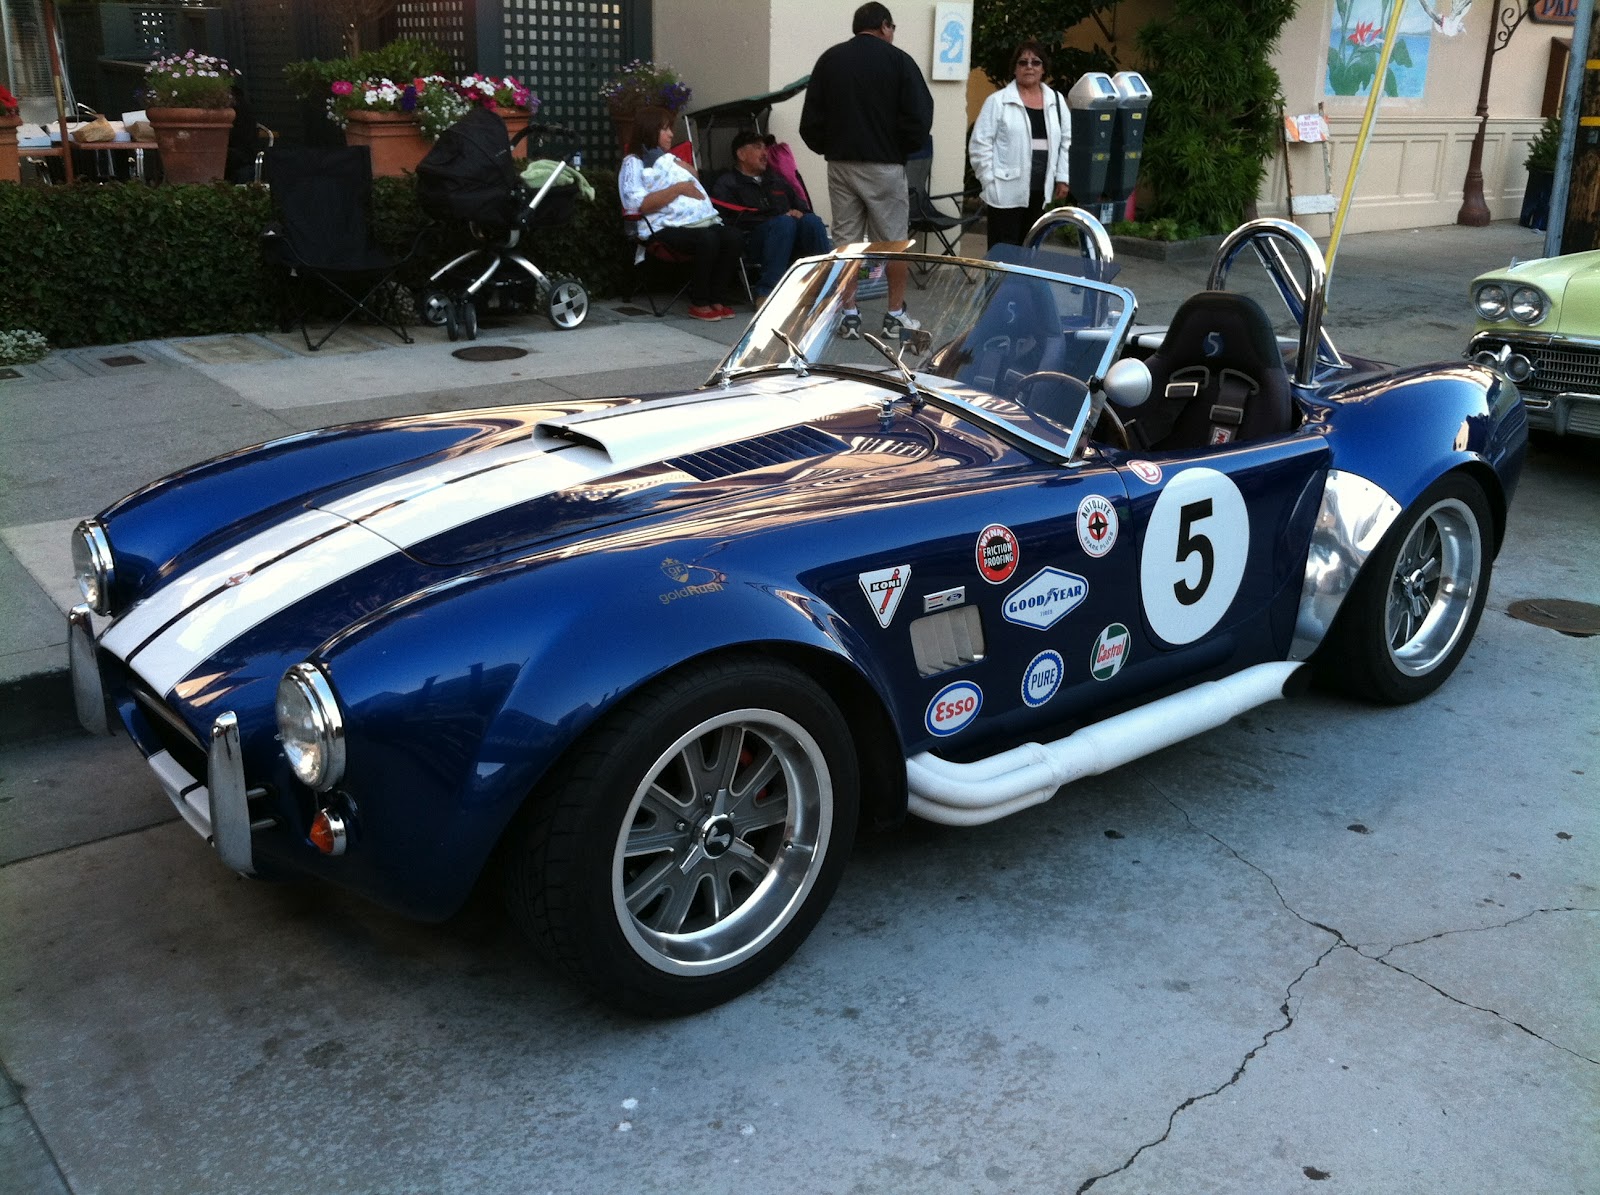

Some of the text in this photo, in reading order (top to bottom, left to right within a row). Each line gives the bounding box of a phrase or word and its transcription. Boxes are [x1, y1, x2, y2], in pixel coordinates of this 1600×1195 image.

[1081, 499, 1111, 520] AUTOLITE
[980, 528, 1012, 547] WYNN'S
[1083, 536, 1099, 551] SPARK
[983, 542, 1013, 558] FRICTION
[1173, 498, 1213, 606] 5
[983, 552, 1014, 568] PROOFING
[872, 579, 900, 591] KONI
[1097, 637, 1125, 663] Castrol
[1031, 667, 1056, 690] PURE
